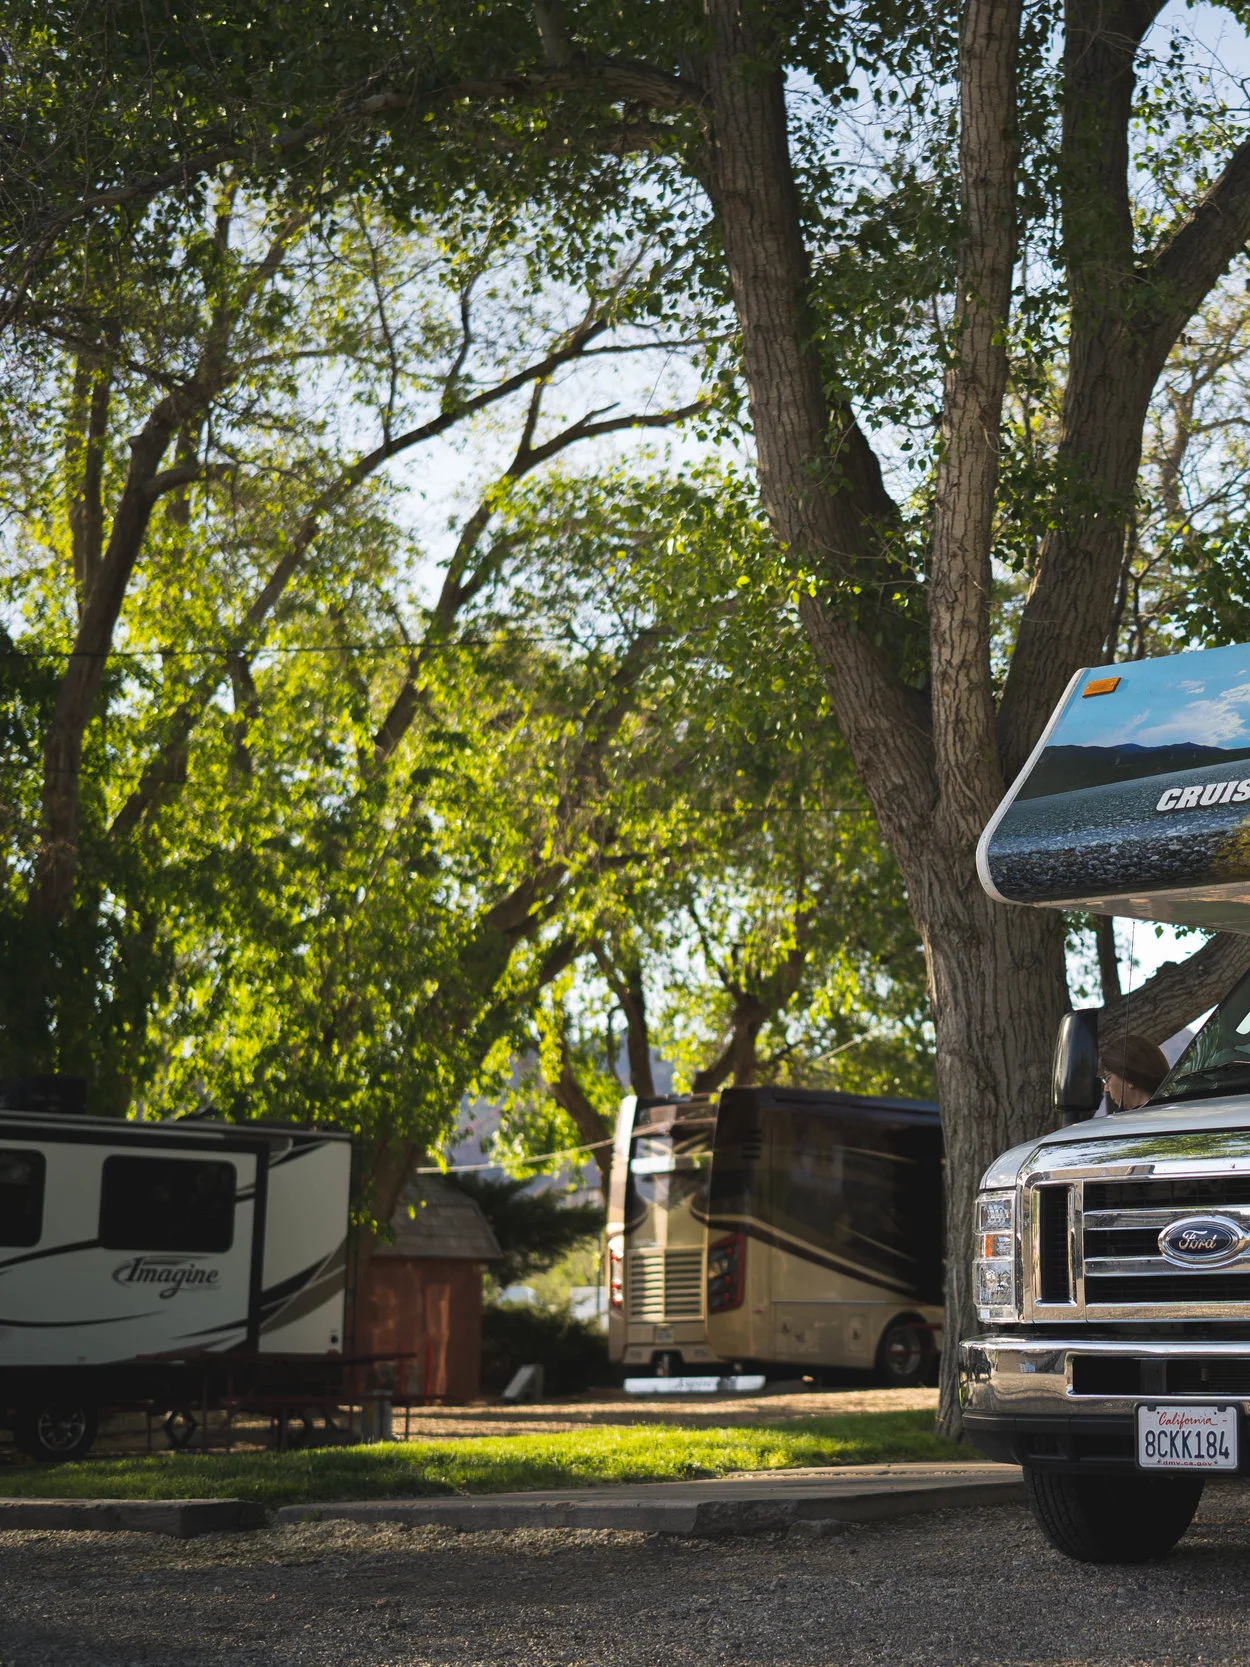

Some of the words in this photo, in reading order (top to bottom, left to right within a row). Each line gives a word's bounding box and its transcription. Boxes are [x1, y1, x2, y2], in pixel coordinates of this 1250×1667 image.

[1178, 1229, 1218, 1250] Ford
[125, 1256, 219, 1300] Imagine
[1158, 1411, 1218, 1430] California
[1145, 1429, 1230, 1460] 8CKK184
